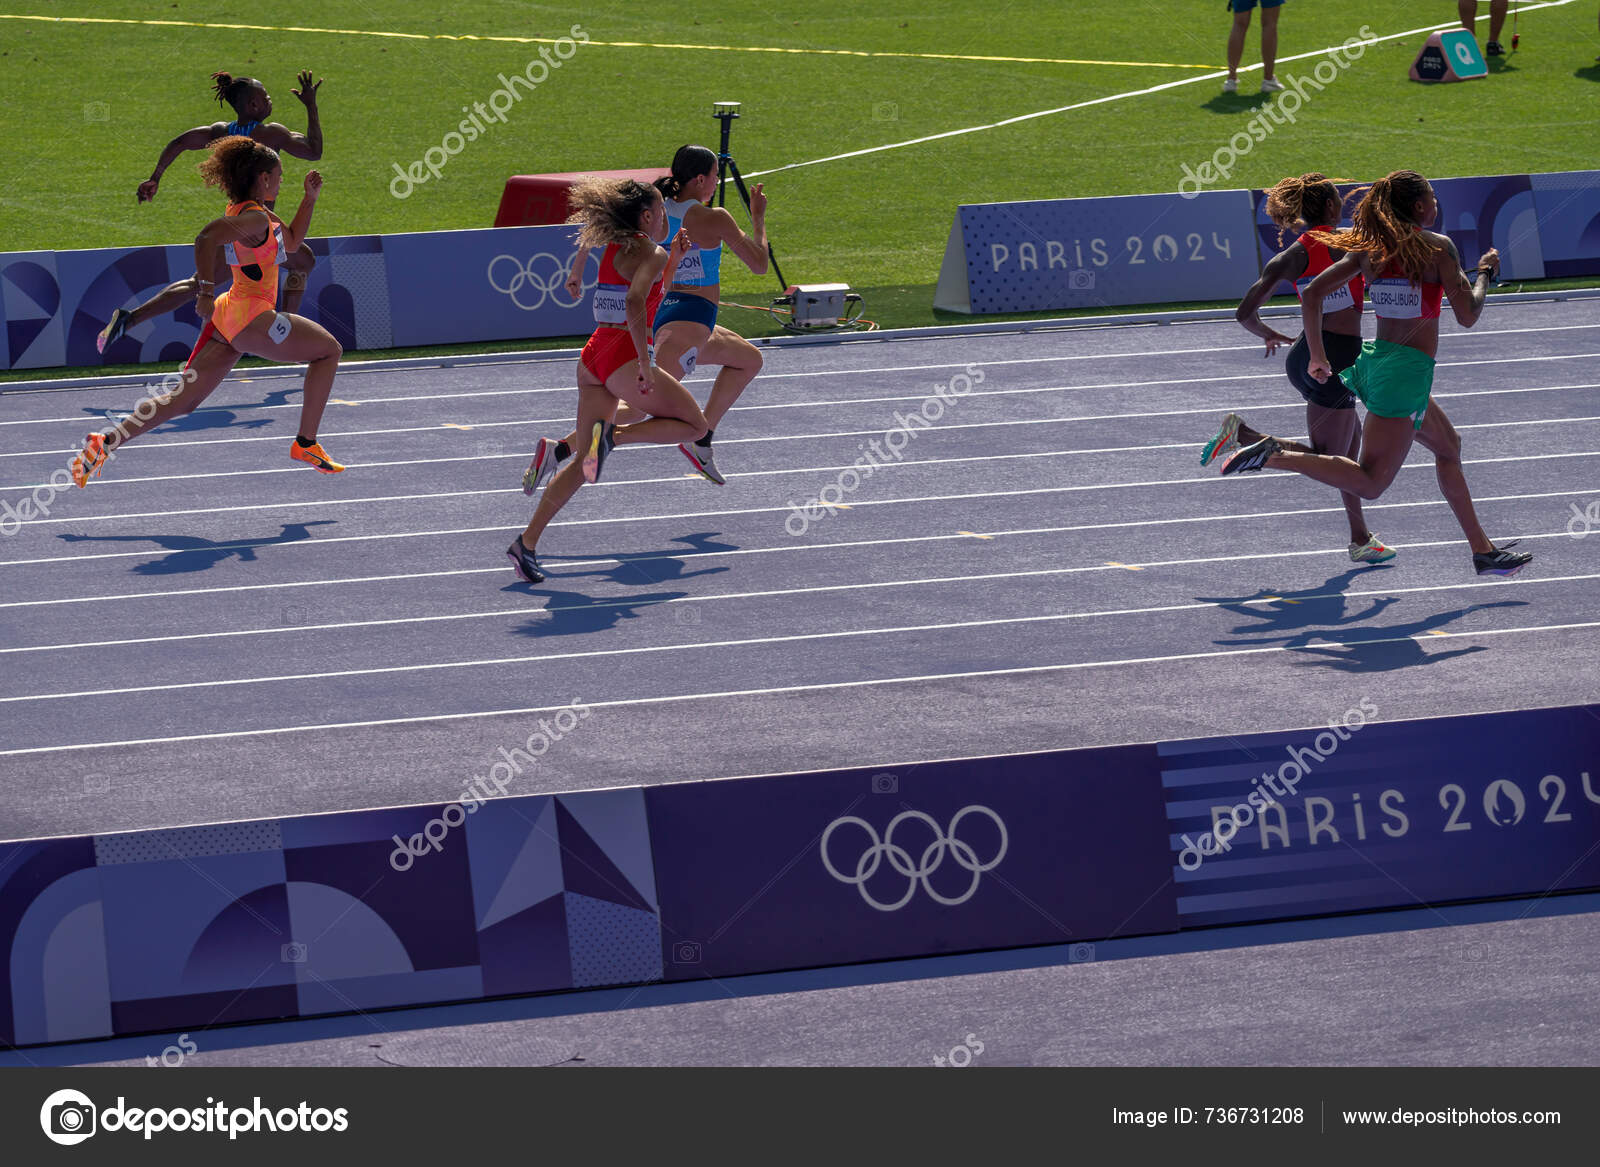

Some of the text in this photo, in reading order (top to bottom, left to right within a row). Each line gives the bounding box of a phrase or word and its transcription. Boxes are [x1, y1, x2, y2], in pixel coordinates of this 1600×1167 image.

[1455, 42, 1475, 65] Q
[1126, 231, 1232, 265] 2024
[276, 323, 287, 335] 5
